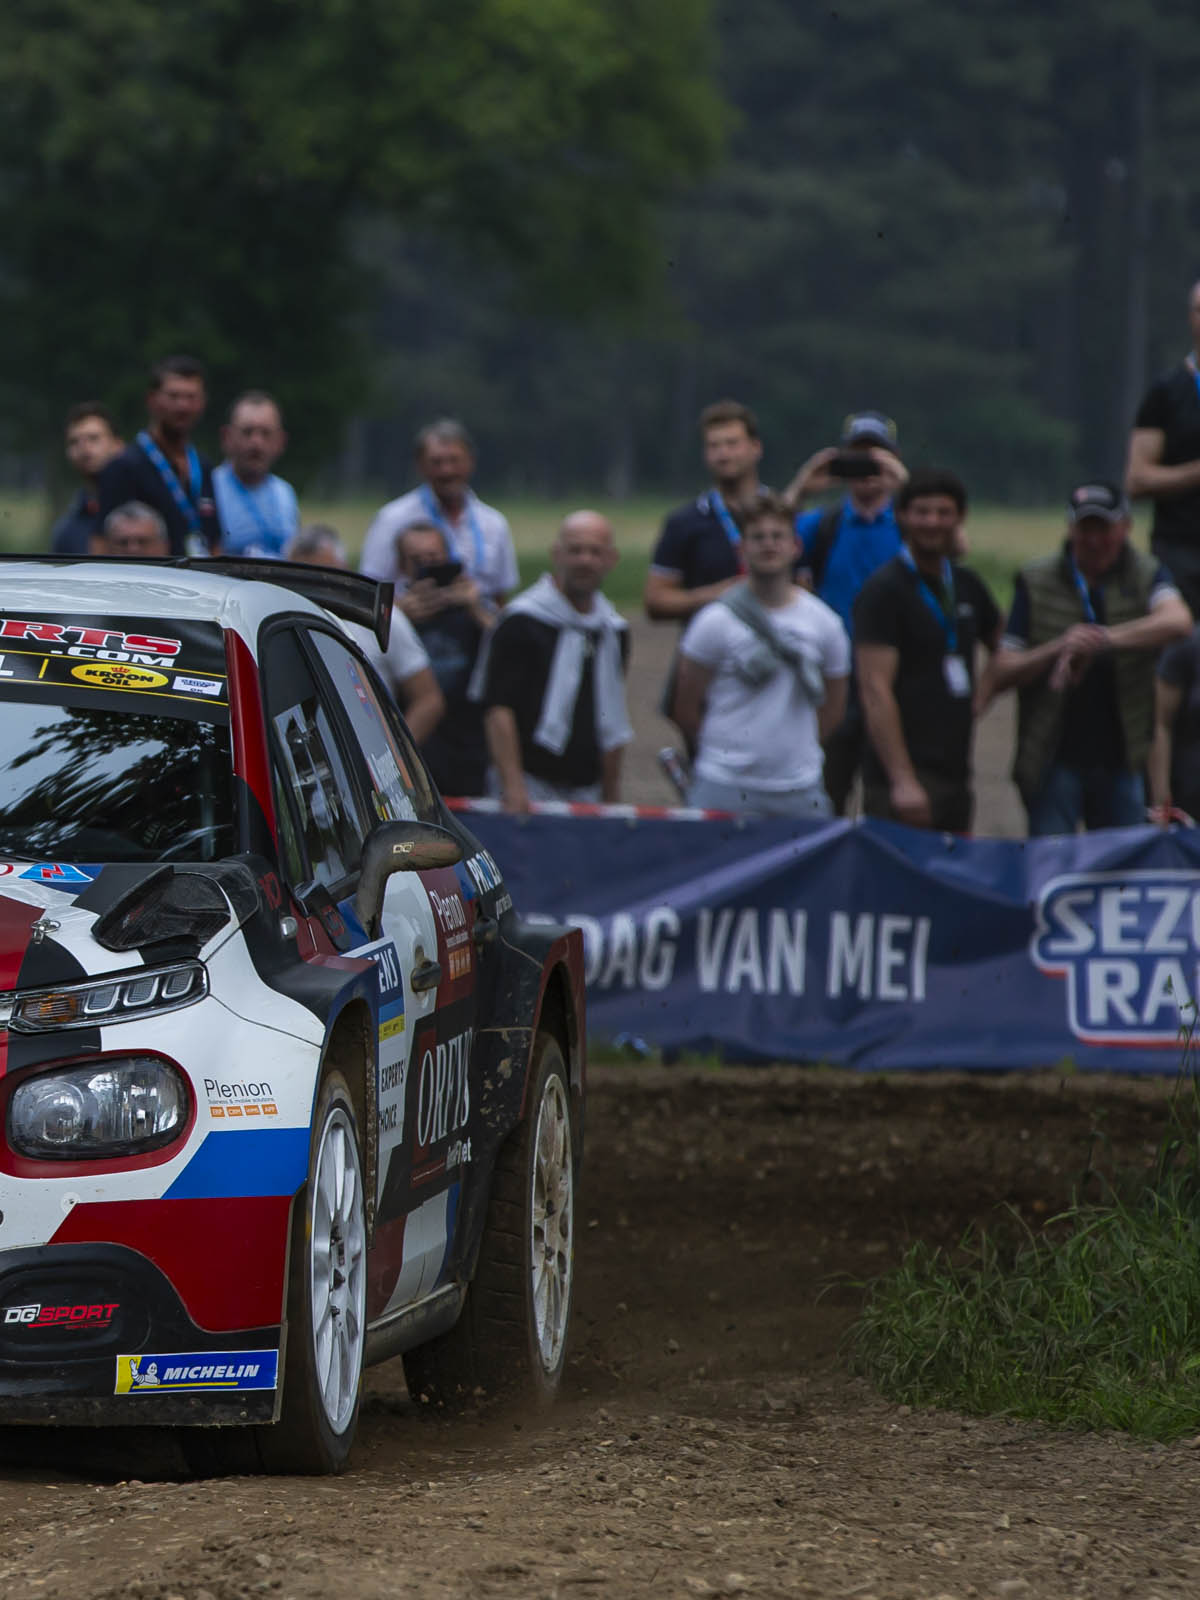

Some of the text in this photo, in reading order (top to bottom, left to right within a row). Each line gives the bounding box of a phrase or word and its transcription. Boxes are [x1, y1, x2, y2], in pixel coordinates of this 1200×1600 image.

[50, 645, 176, 668] .COM
[84, 669, 155, 683] KROON
[100, 676, 132, 687] OIL
[1048, 887, 1200, 954] SEZ
[527, 905, 931, 1000] DAG VAN MEI
[367, 947, 399, 994] ENS
[1087, 957, 1200, 1025] RA
[203, 1078, 273, 1098] Plenion
[162, 1364, 261, 1381] MICHELIN
